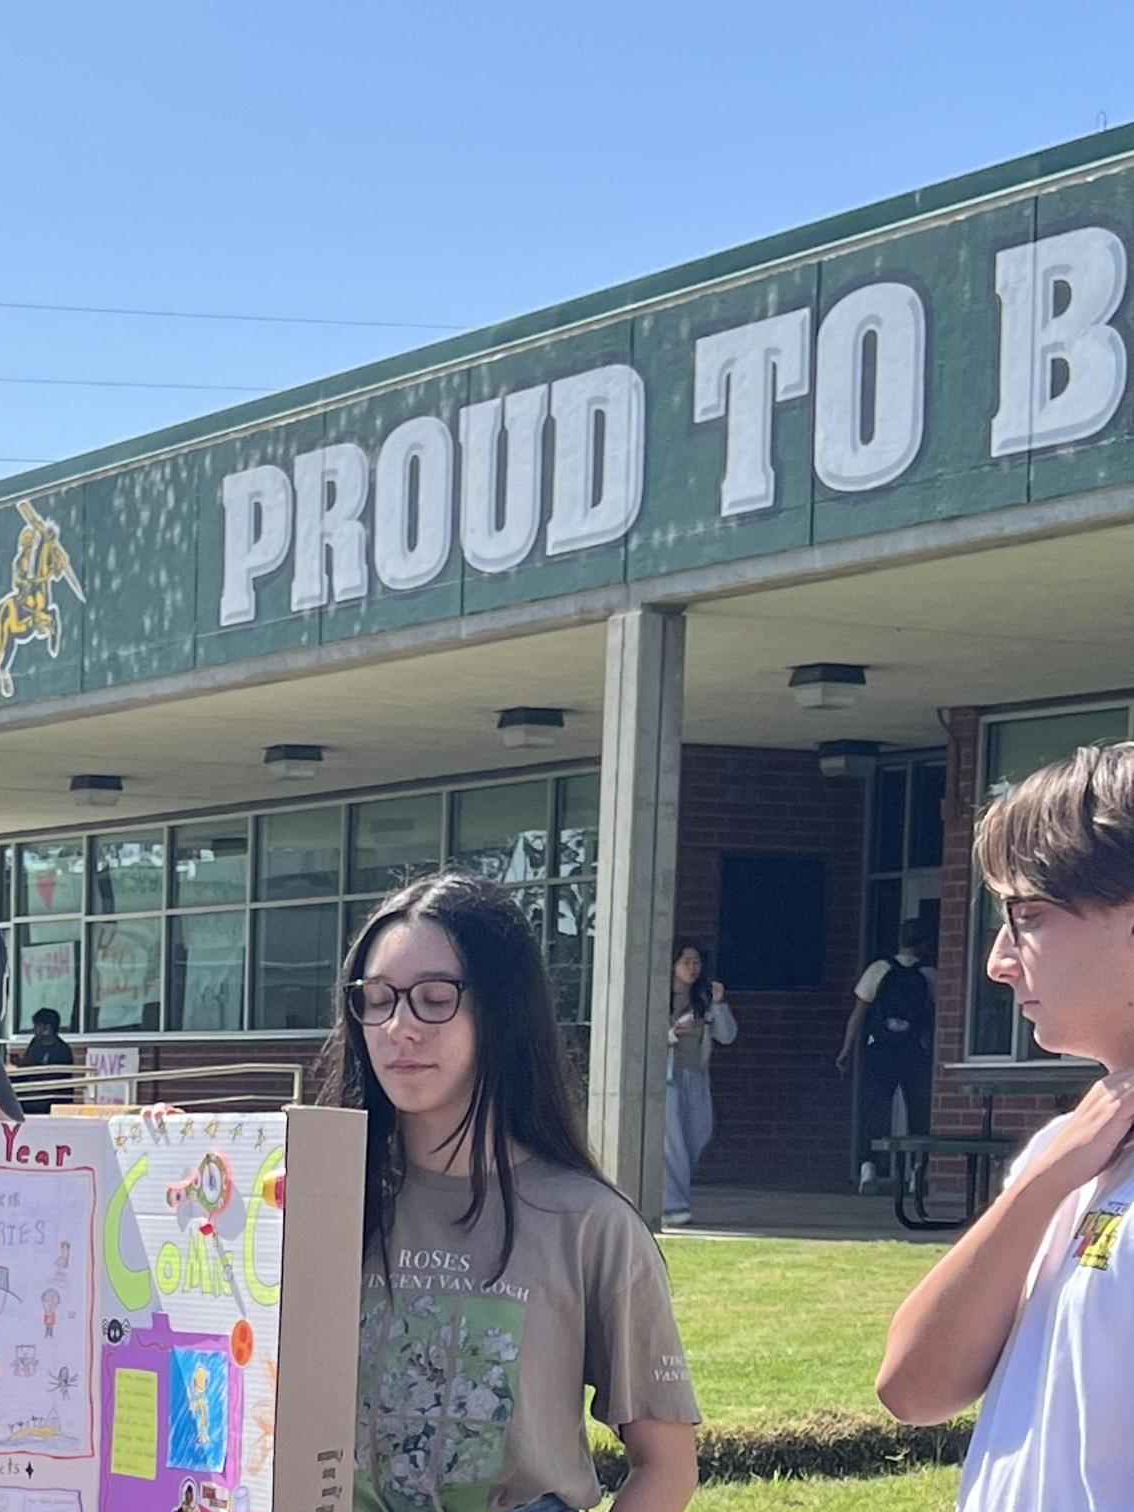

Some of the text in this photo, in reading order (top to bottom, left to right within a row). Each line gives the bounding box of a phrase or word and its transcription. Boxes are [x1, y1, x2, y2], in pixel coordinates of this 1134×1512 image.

[219, 225, 1128, 627] PROUD TO B
[1, 1122, 72, 1167] Year
[398, 1249, 472, 1272] ROSES
[439, 1274, 475, 1292] VAN
